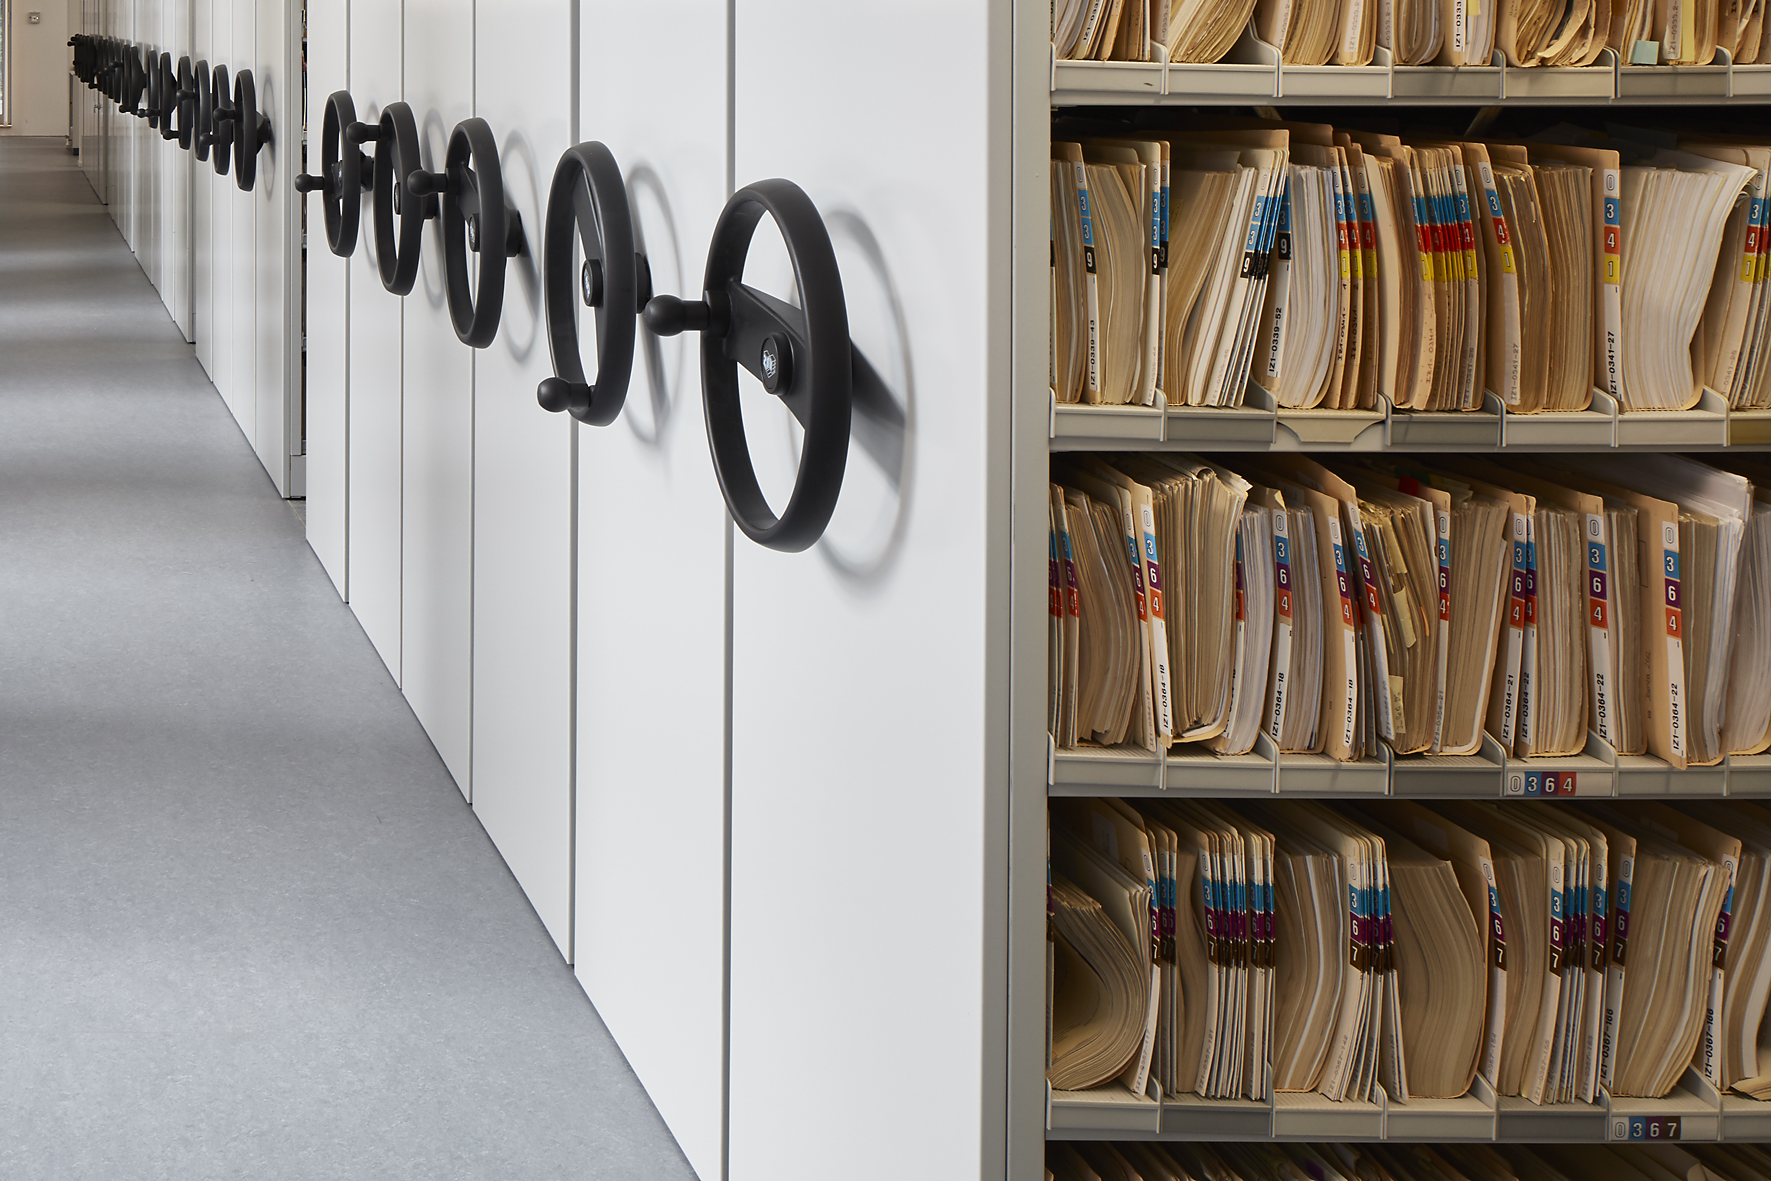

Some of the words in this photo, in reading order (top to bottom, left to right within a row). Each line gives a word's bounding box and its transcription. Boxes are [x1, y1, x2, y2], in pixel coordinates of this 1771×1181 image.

[1268, 307, 1283, 372] IZ1-0339-52
[1608, 331, 1618, 395] IZ1-0341-27
[1159, 664, 1169, 729] IZ1-0364-18
[1272, 672, 1285, 737] IZ1-0364-18
[1345, 679, 1354, 744] IZ1-0364-18
[1502, 674, 1514, 738] IZ1-0364-21
[1597, 673, 1606, 738] IZ1-0364-22
[1671, 683, 1679, 749] IZ1-0364-22
[1510, 775, 1573, 793] 0364
[1600, 1009, 1614, 1079] IZ1-0367-166
[1705, 1008, 1715, 1079] IZ1-0367-166
[1614, 1121, 1678, 1138] 0367
